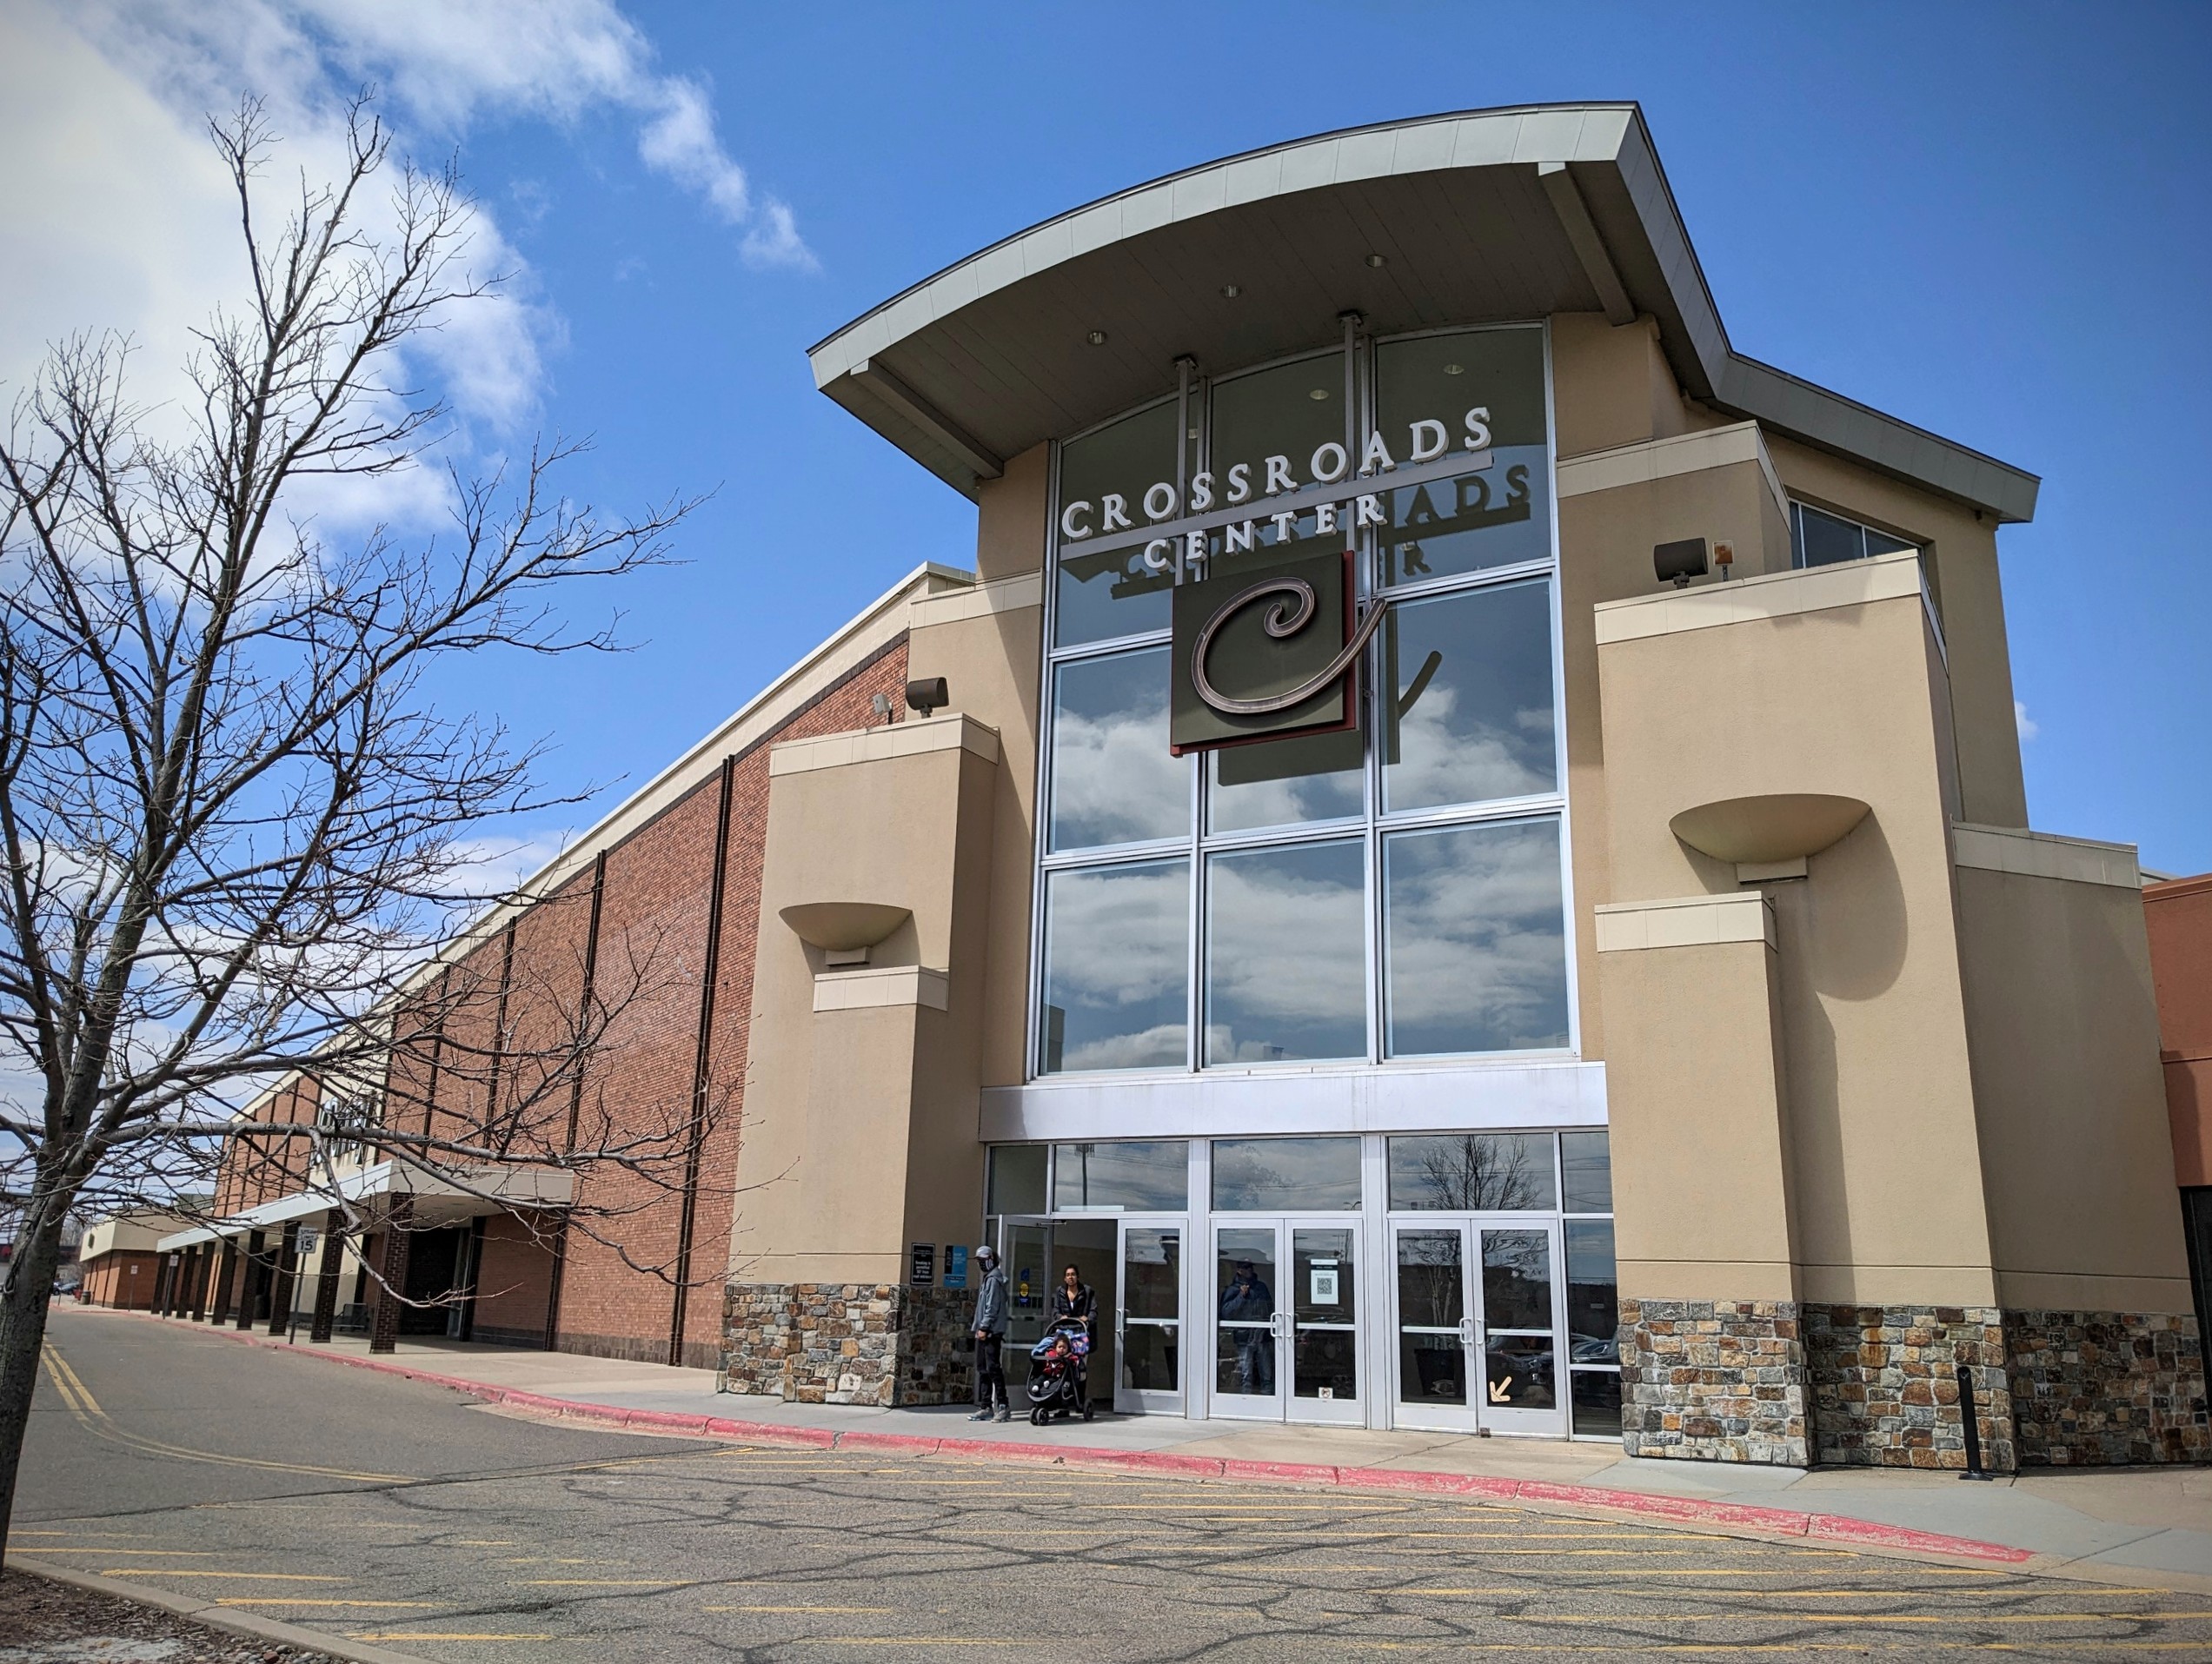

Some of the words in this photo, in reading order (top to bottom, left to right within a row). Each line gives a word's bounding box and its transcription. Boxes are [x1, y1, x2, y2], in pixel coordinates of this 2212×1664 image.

[1061, 407, 1491, 540] CROSSROADS
[1144, 494, 1387, 571] CENTER
[300, 1240, 313, 1251] 15
